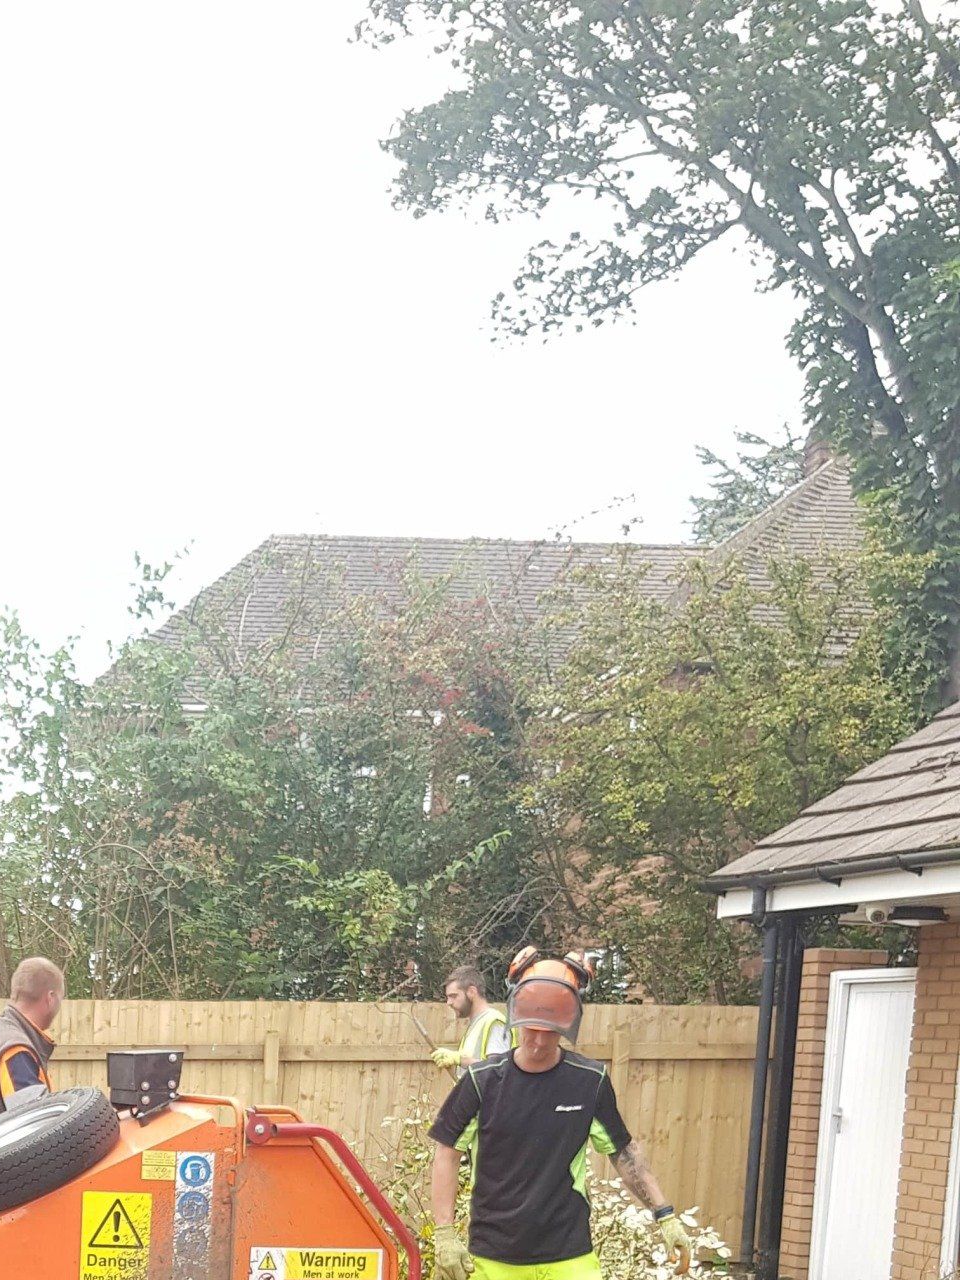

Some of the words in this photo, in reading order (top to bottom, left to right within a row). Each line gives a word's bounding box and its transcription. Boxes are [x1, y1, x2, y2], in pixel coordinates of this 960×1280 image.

[86, 1254, 144, 1271] Danger
[299, 1252, 367, 1271] Warning
[303, 1270, 322, 1279] Men
[325, 1271, 335, 1279] at
[338, 1271, 360, 1279] work
